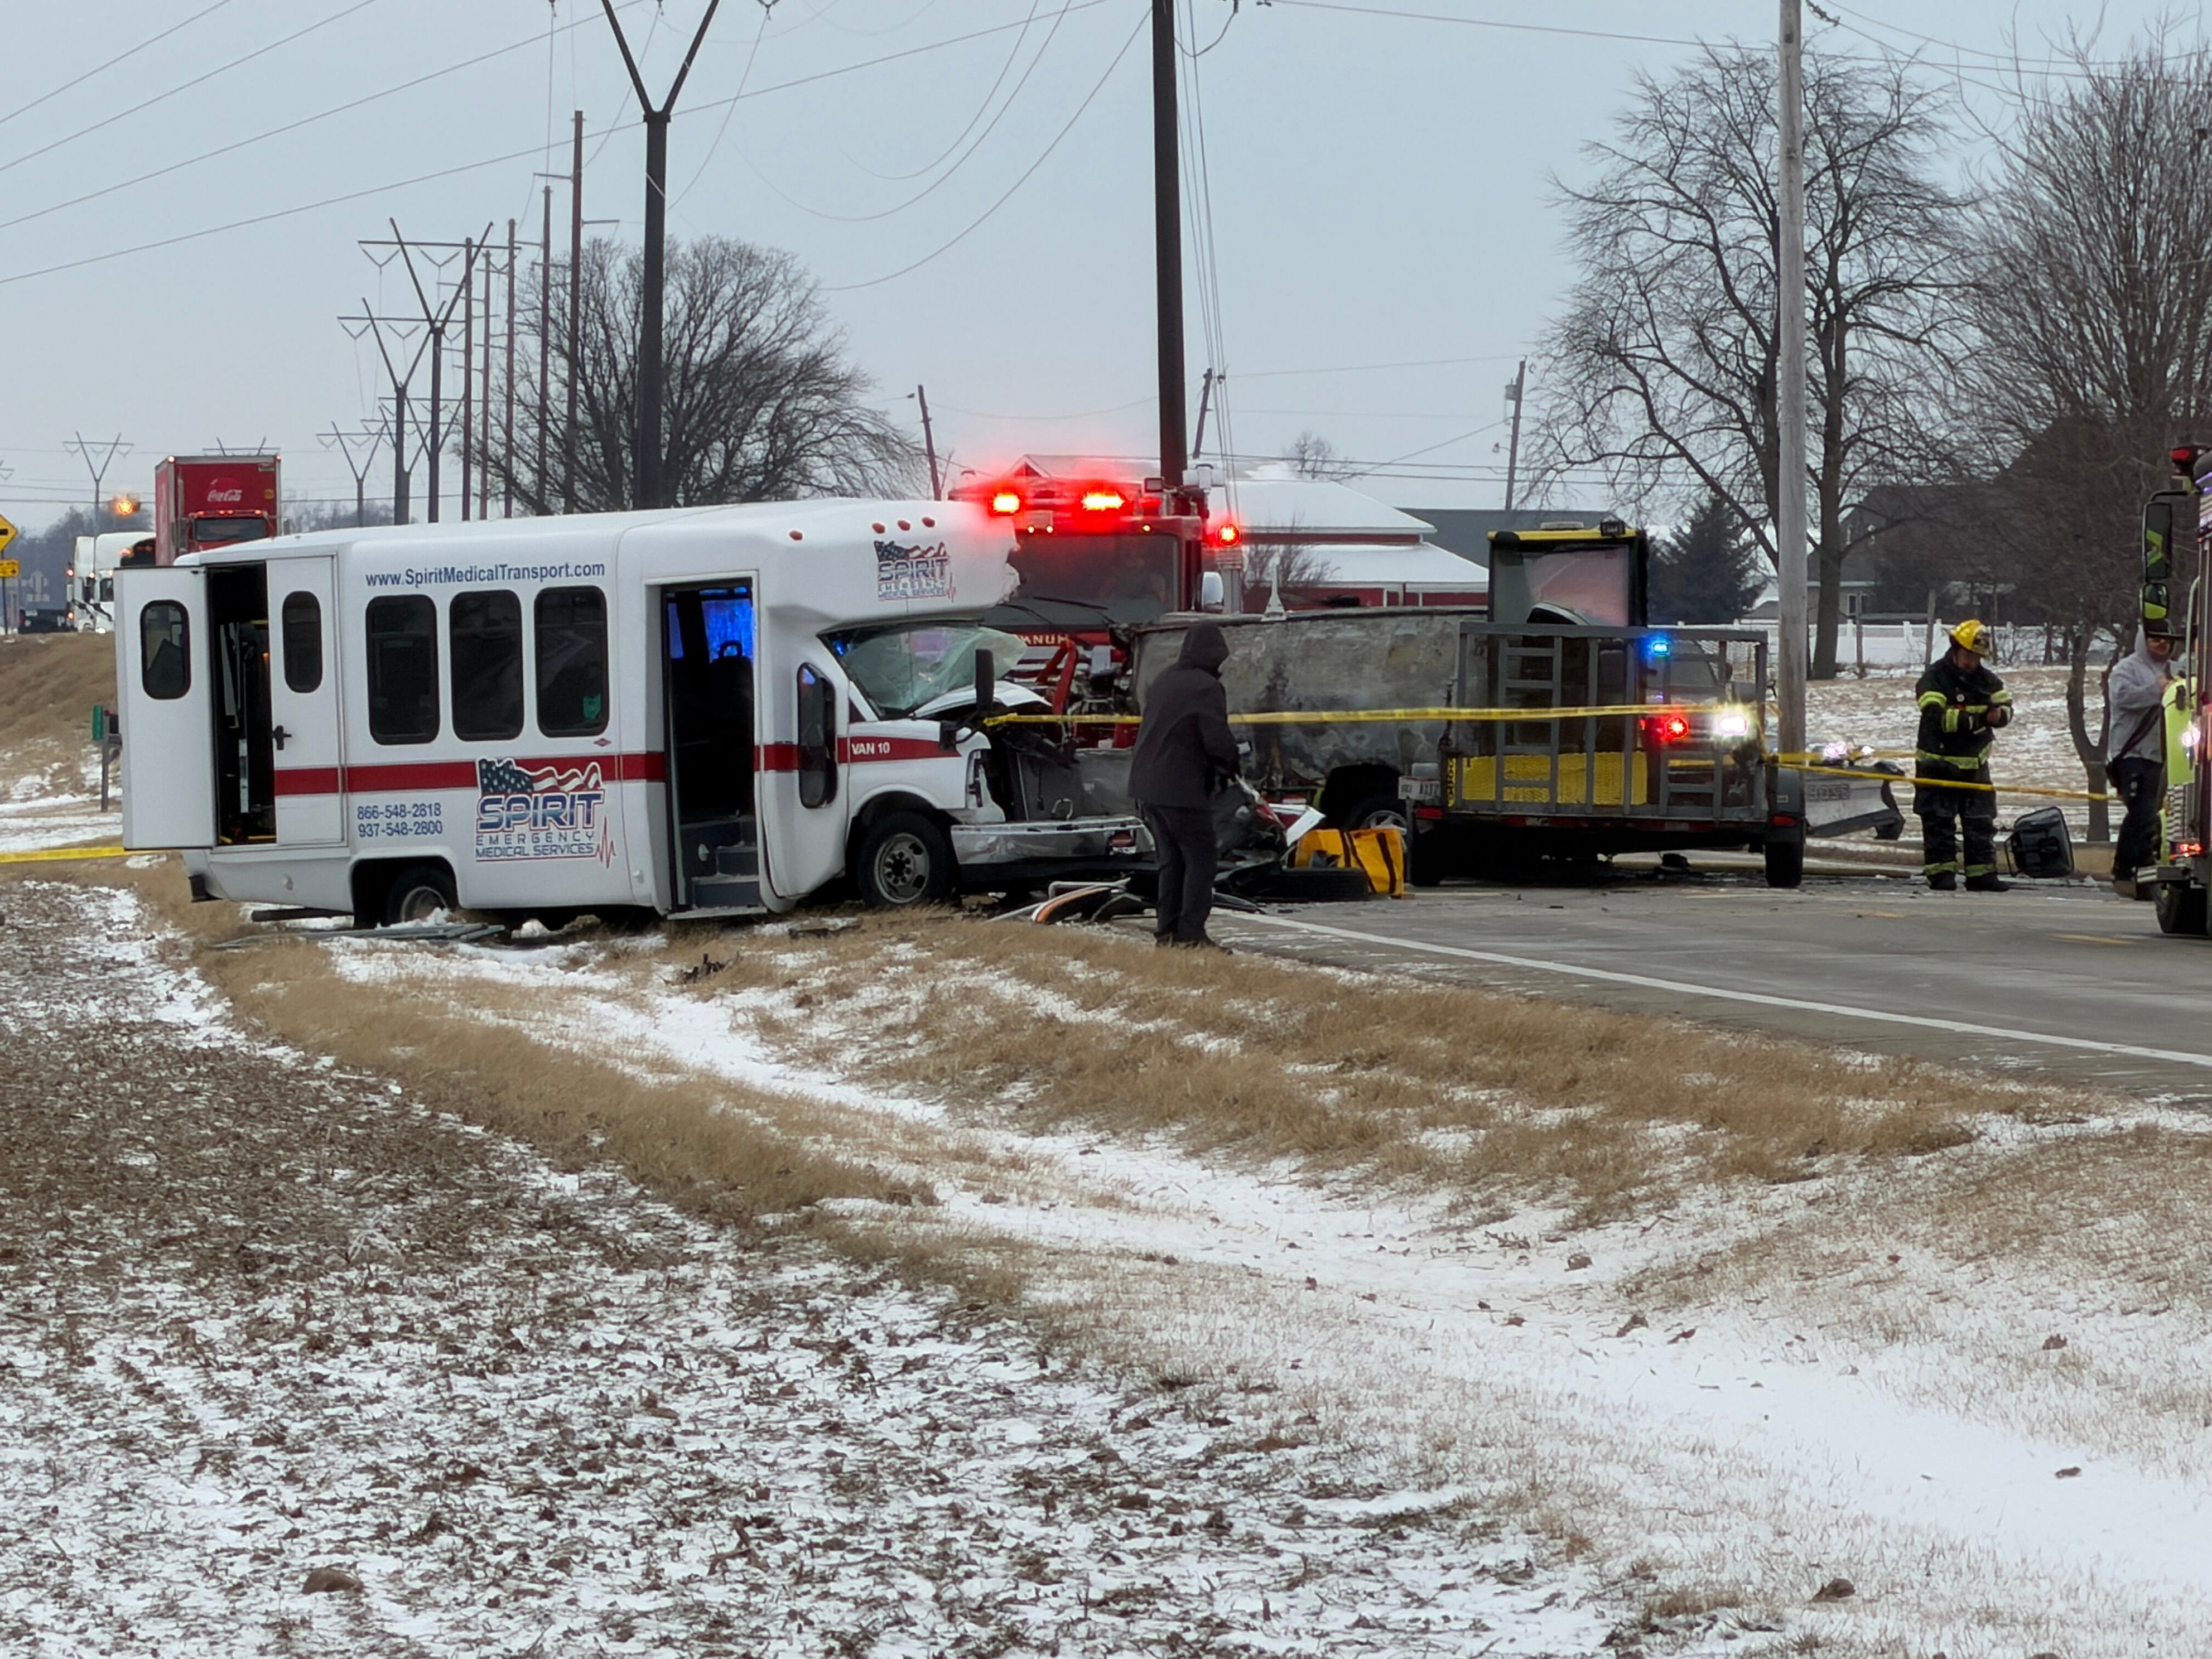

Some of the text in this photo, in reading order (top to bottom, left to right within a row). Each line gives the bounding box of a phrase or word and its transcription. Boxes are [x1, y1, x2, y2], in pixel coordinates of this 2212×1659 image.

[365, 562, 605, 587] www.SpiritMedicalTransport.com
[878, 558, 948, 581] SPIRIT
[851, 741, 890, 755] VAN 10
[357, 802, 441, 820] 866-548-2818
[479, 793, 603, 830] SPIRIT
[358, 820, 443, 837] 937-548-2800
[476, 831, 595, 846] EMERGENCY
[475, 843, 595, 858] MEDICAL SERVICES
